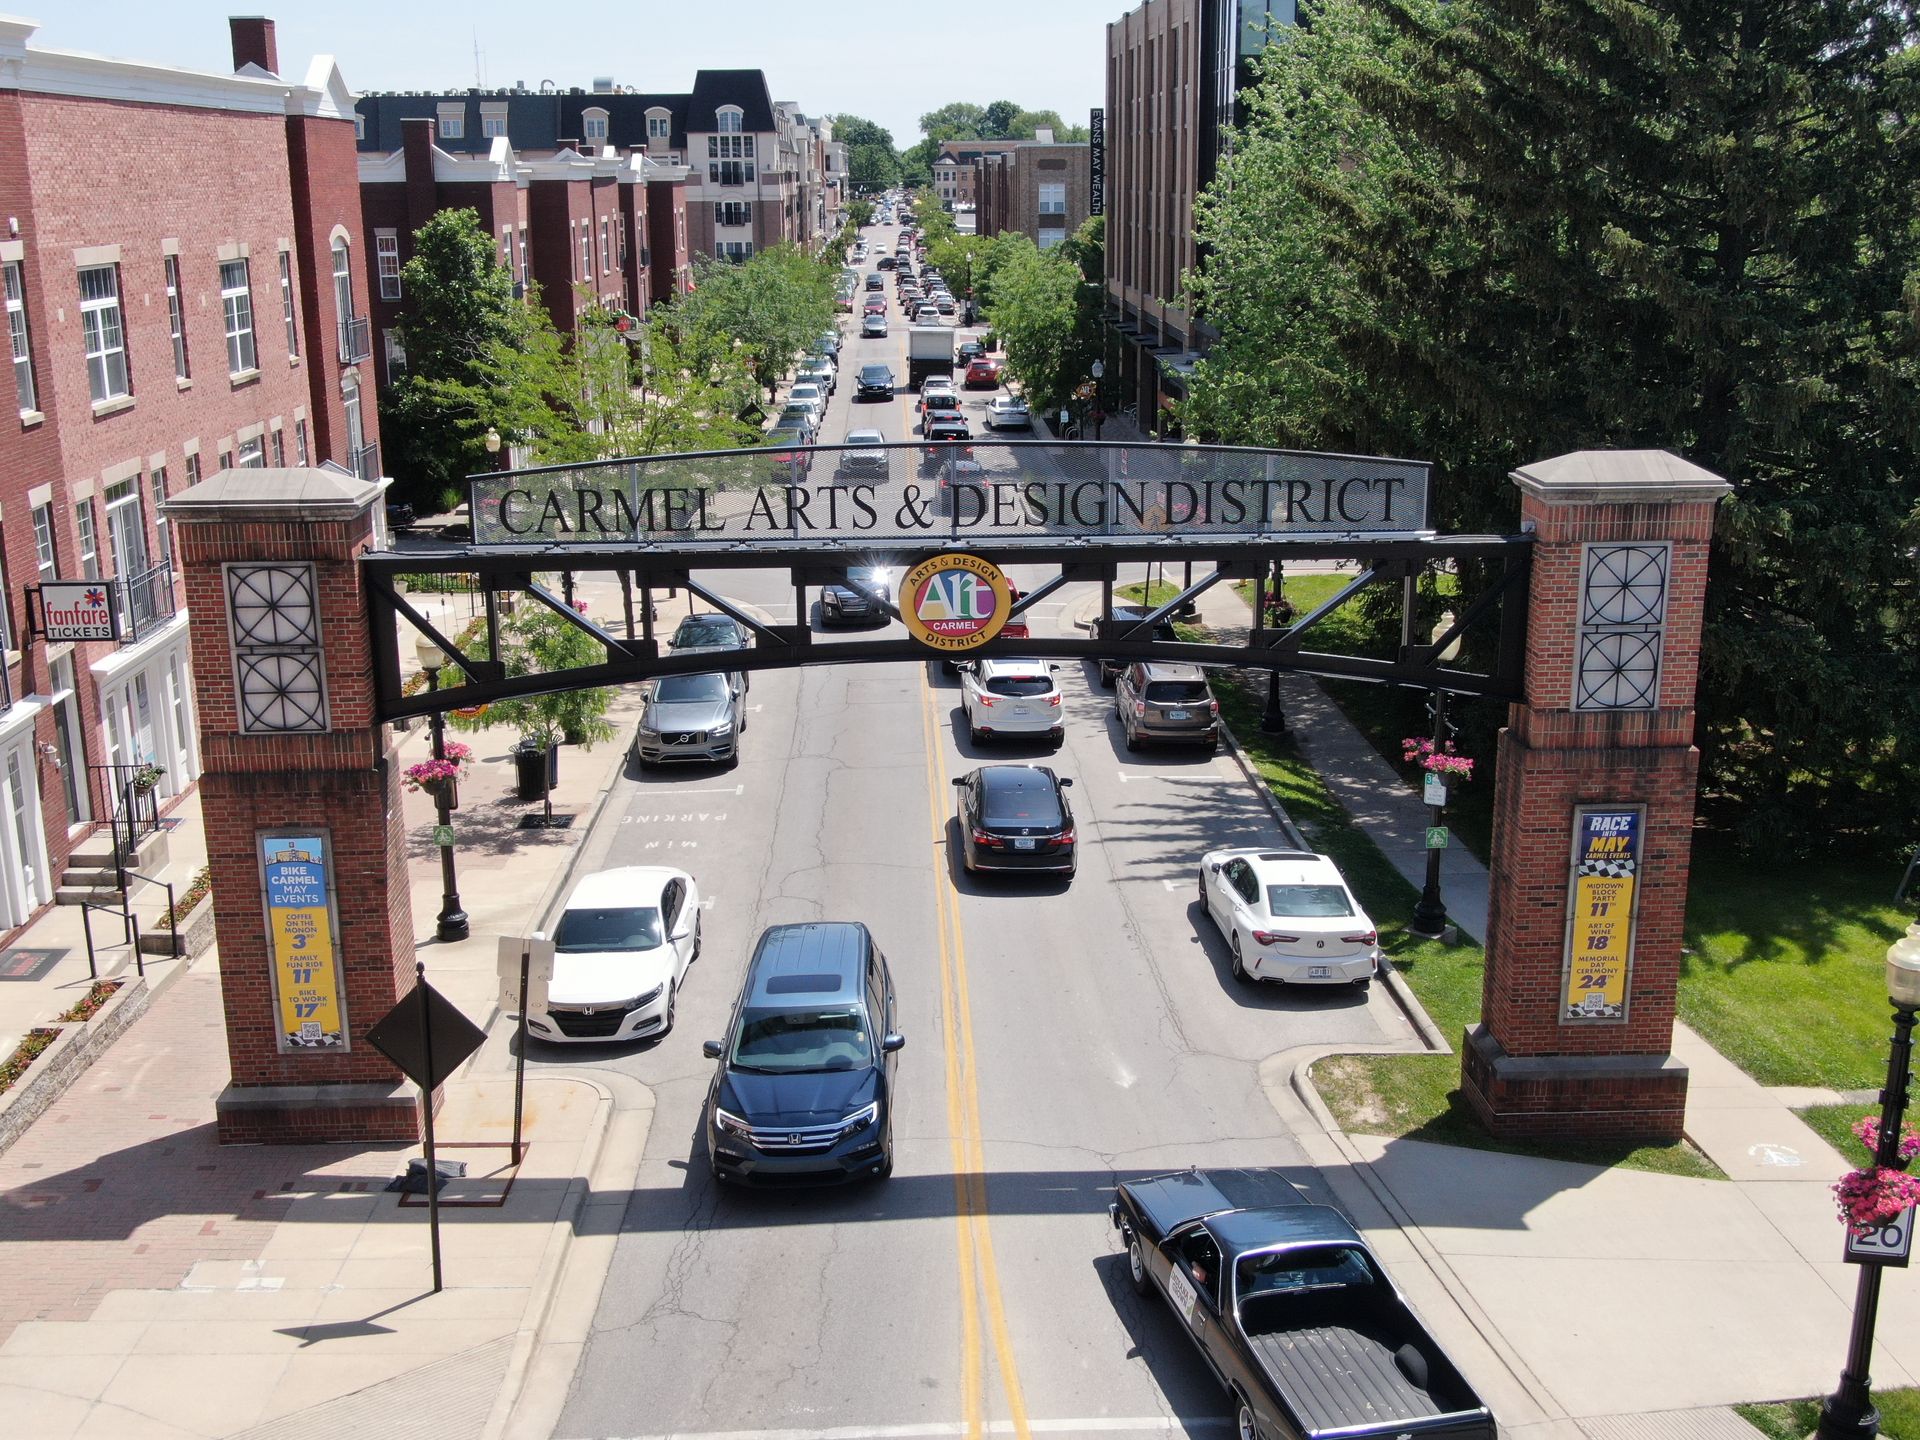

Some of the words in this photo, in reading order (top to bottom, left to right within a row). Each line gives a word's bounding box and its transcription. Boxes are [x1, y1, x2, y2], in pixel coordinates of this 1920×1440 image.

[1092, 110, 1102, 144] EVANS
[1092, 147, 1101, 171] MAY
[1092, 174, 1101, 214] WEALTH
[500, 487, 727, 534] CARMEL
[745, 484, 877, 531] ARTS
[895, 484, 935, 529] &
[951, 480, 1150, 528] DESIGN
[1160, 477, 1406, 526] DISTRICT
[910, 561, 938, 586] ARTS
[953, 557, 998, 581] DESIGN
[46, 601, 109, 626] fanfare
[49, 626, 111, 638] TICKETS
[932, 621, 978, 631] CARMEL
[925, 630, 987, 648] DISTRICT
[620, 813, 728, 824] PARKING
[1590, 816, 1632, 831] RACE
[1589, 836, 1630, 852] MAY
[280, 866, 307, 875] BIKE
[271, 876, 319, 885] CARMEL
[284, 885, 307, 894] MAY
[274, 894, 319, 903] EVENTS
